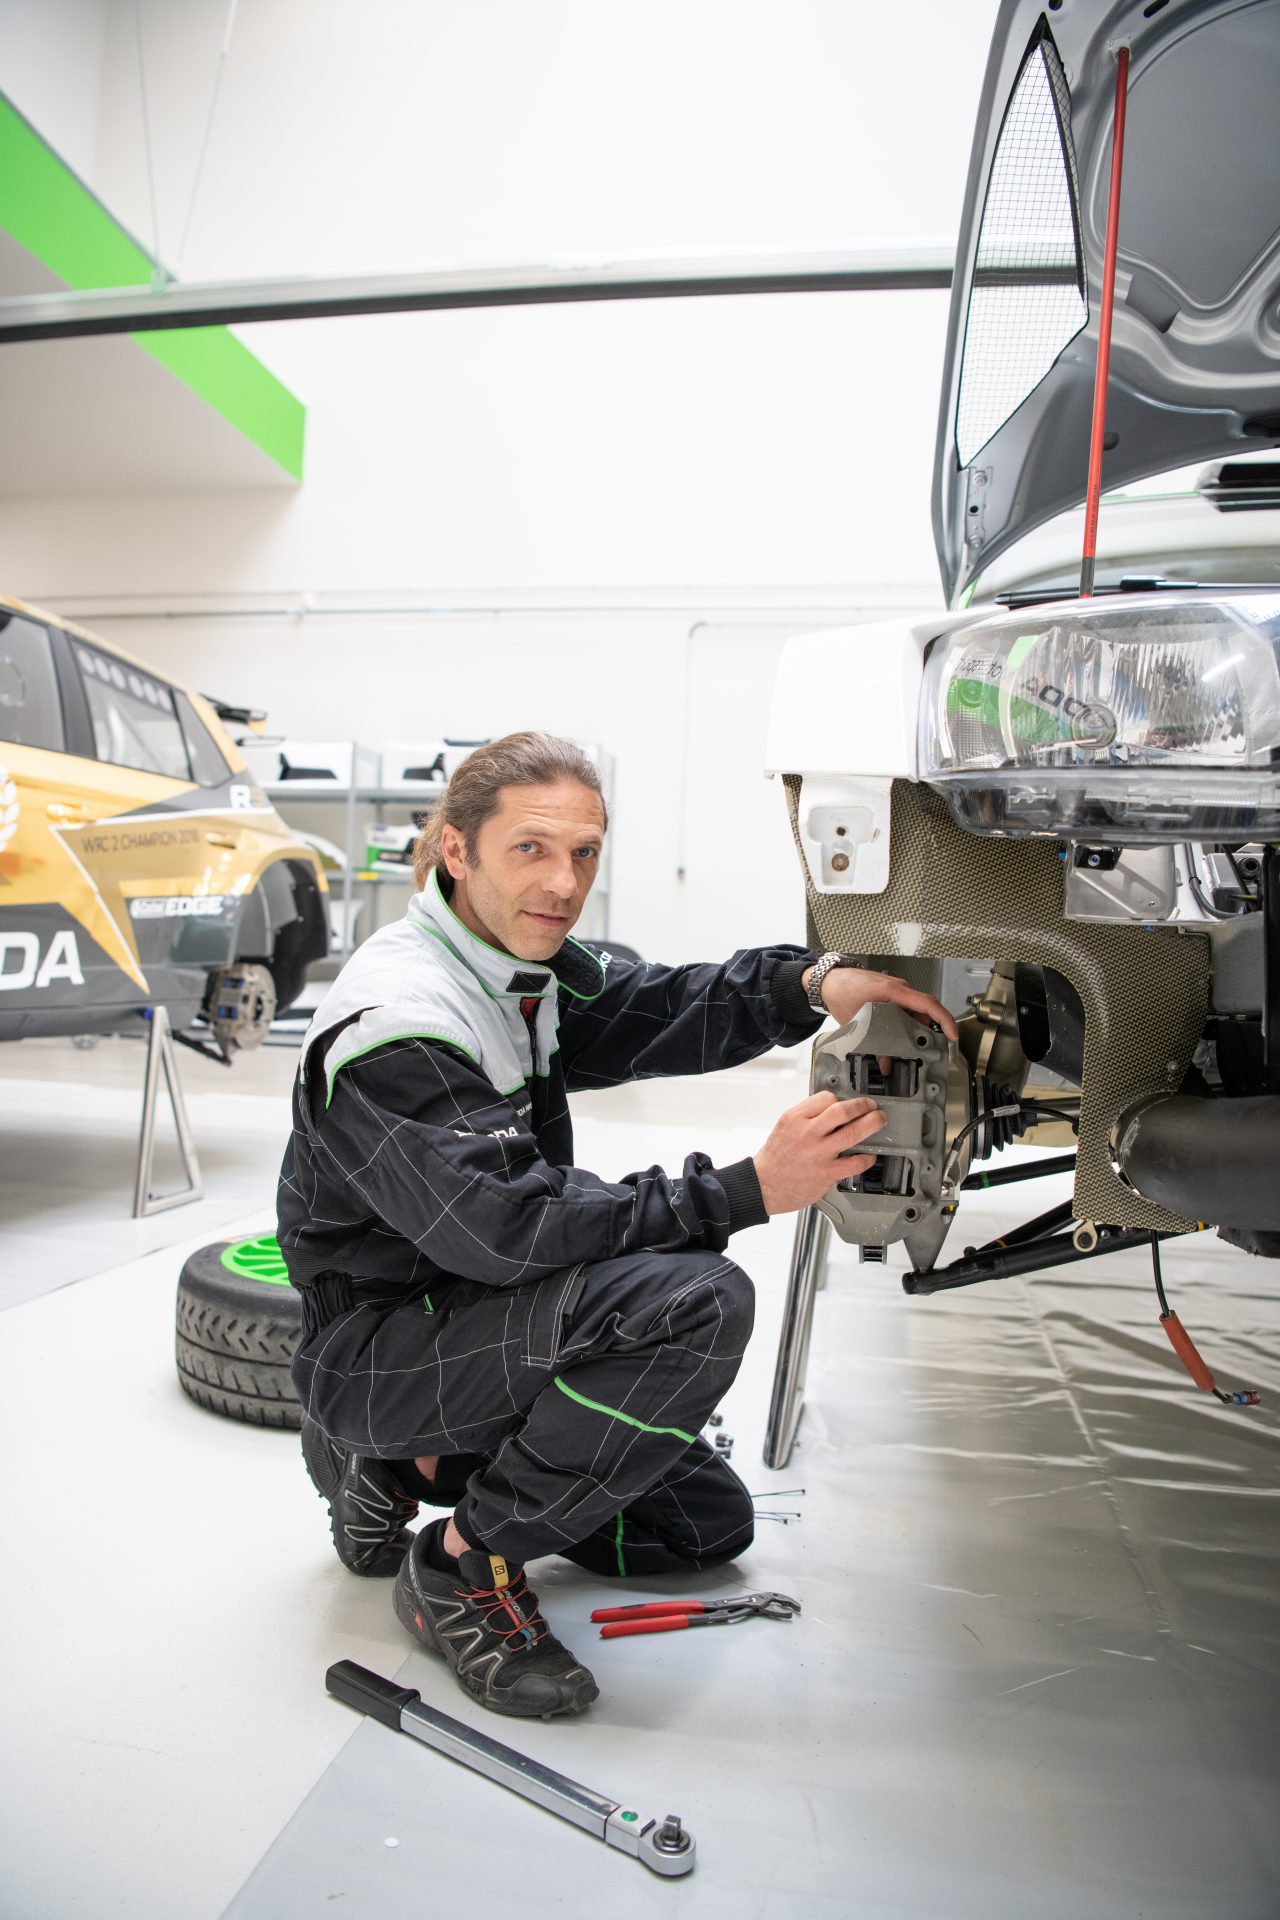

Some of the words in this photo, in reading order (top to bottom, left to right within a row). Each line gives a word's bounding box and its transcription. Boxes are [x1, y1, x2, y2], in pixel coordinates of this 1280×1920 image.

[82, 836, 109, 853] WRC
[111, 834, 119, 852] 2
[120, 831, 177, 850] CHAMPION
[165, 896, 224, 917] EDGE
